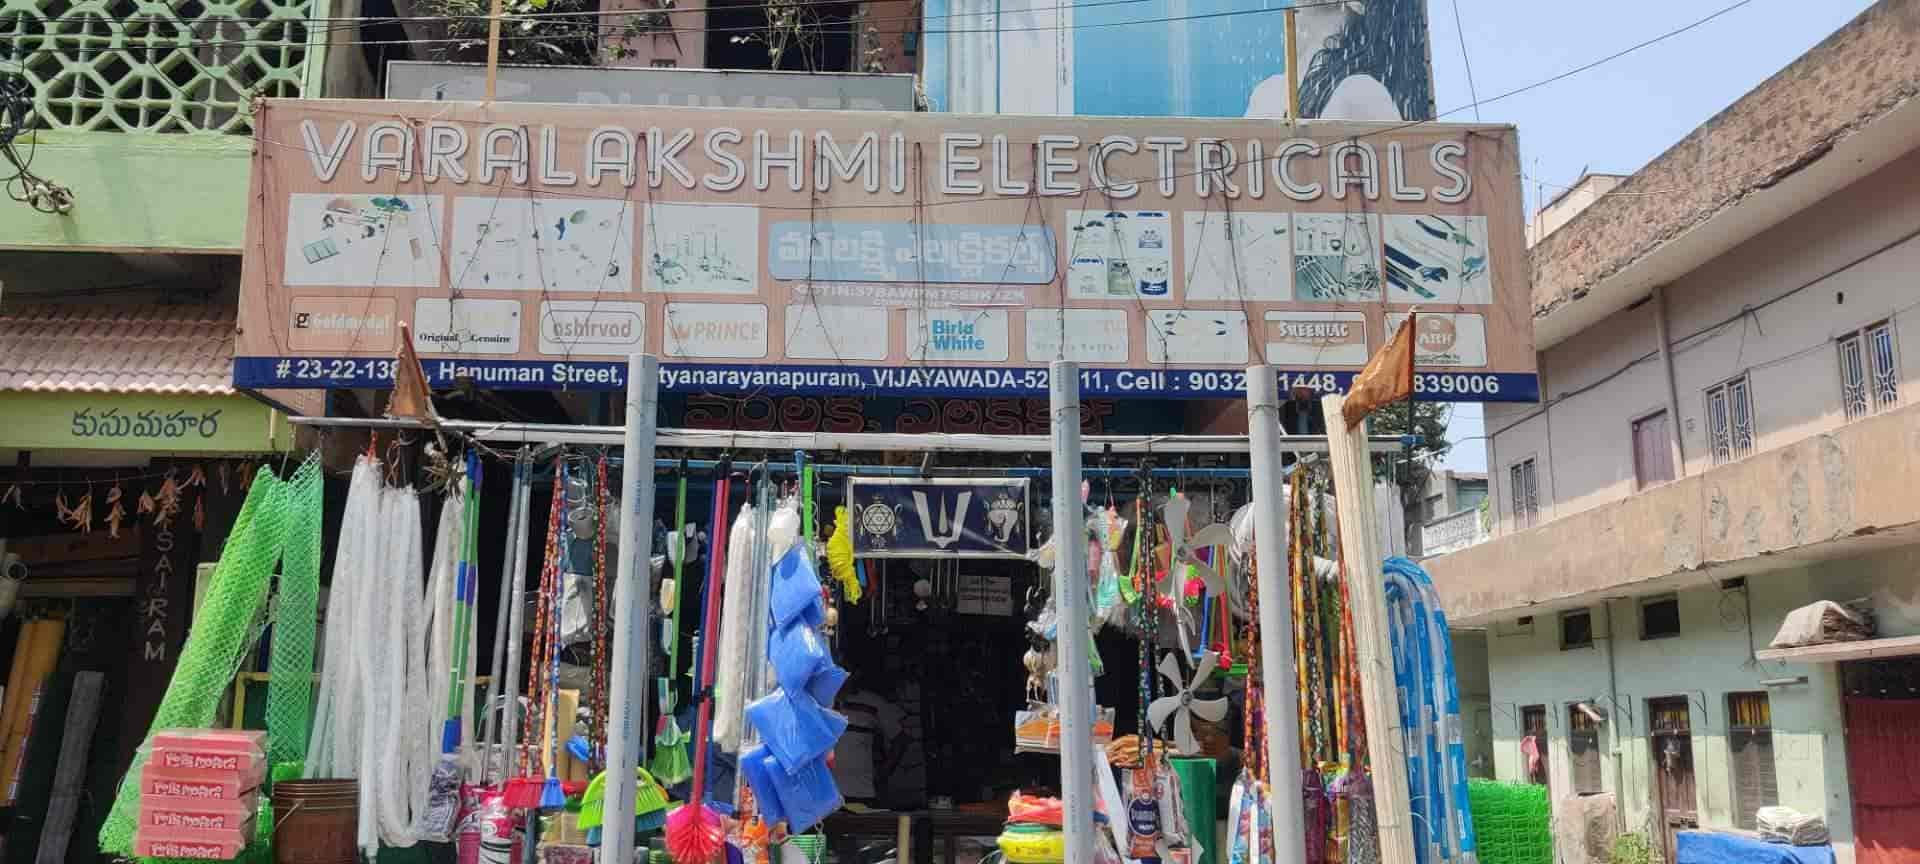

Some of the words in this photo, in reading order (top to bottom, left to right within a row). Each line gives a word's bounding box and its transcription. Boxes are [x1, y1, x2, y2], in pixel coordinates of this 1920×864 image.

[300, 118, 906, 194] VARALAKSHMI
[938, 131, 1475, 203] ELECTRICALS
[694, 320, 760, 341] PRINCE
[931, 319, 975, 336] Birla
[932, 335, 985, 351] White
[439, 362, 544, 384] Hanuman
[551, 362, 623, 387] Street,
[657, 367, 866, 393] tyanarayanapuram,
[1116, 371, 1164, 390] Cell
